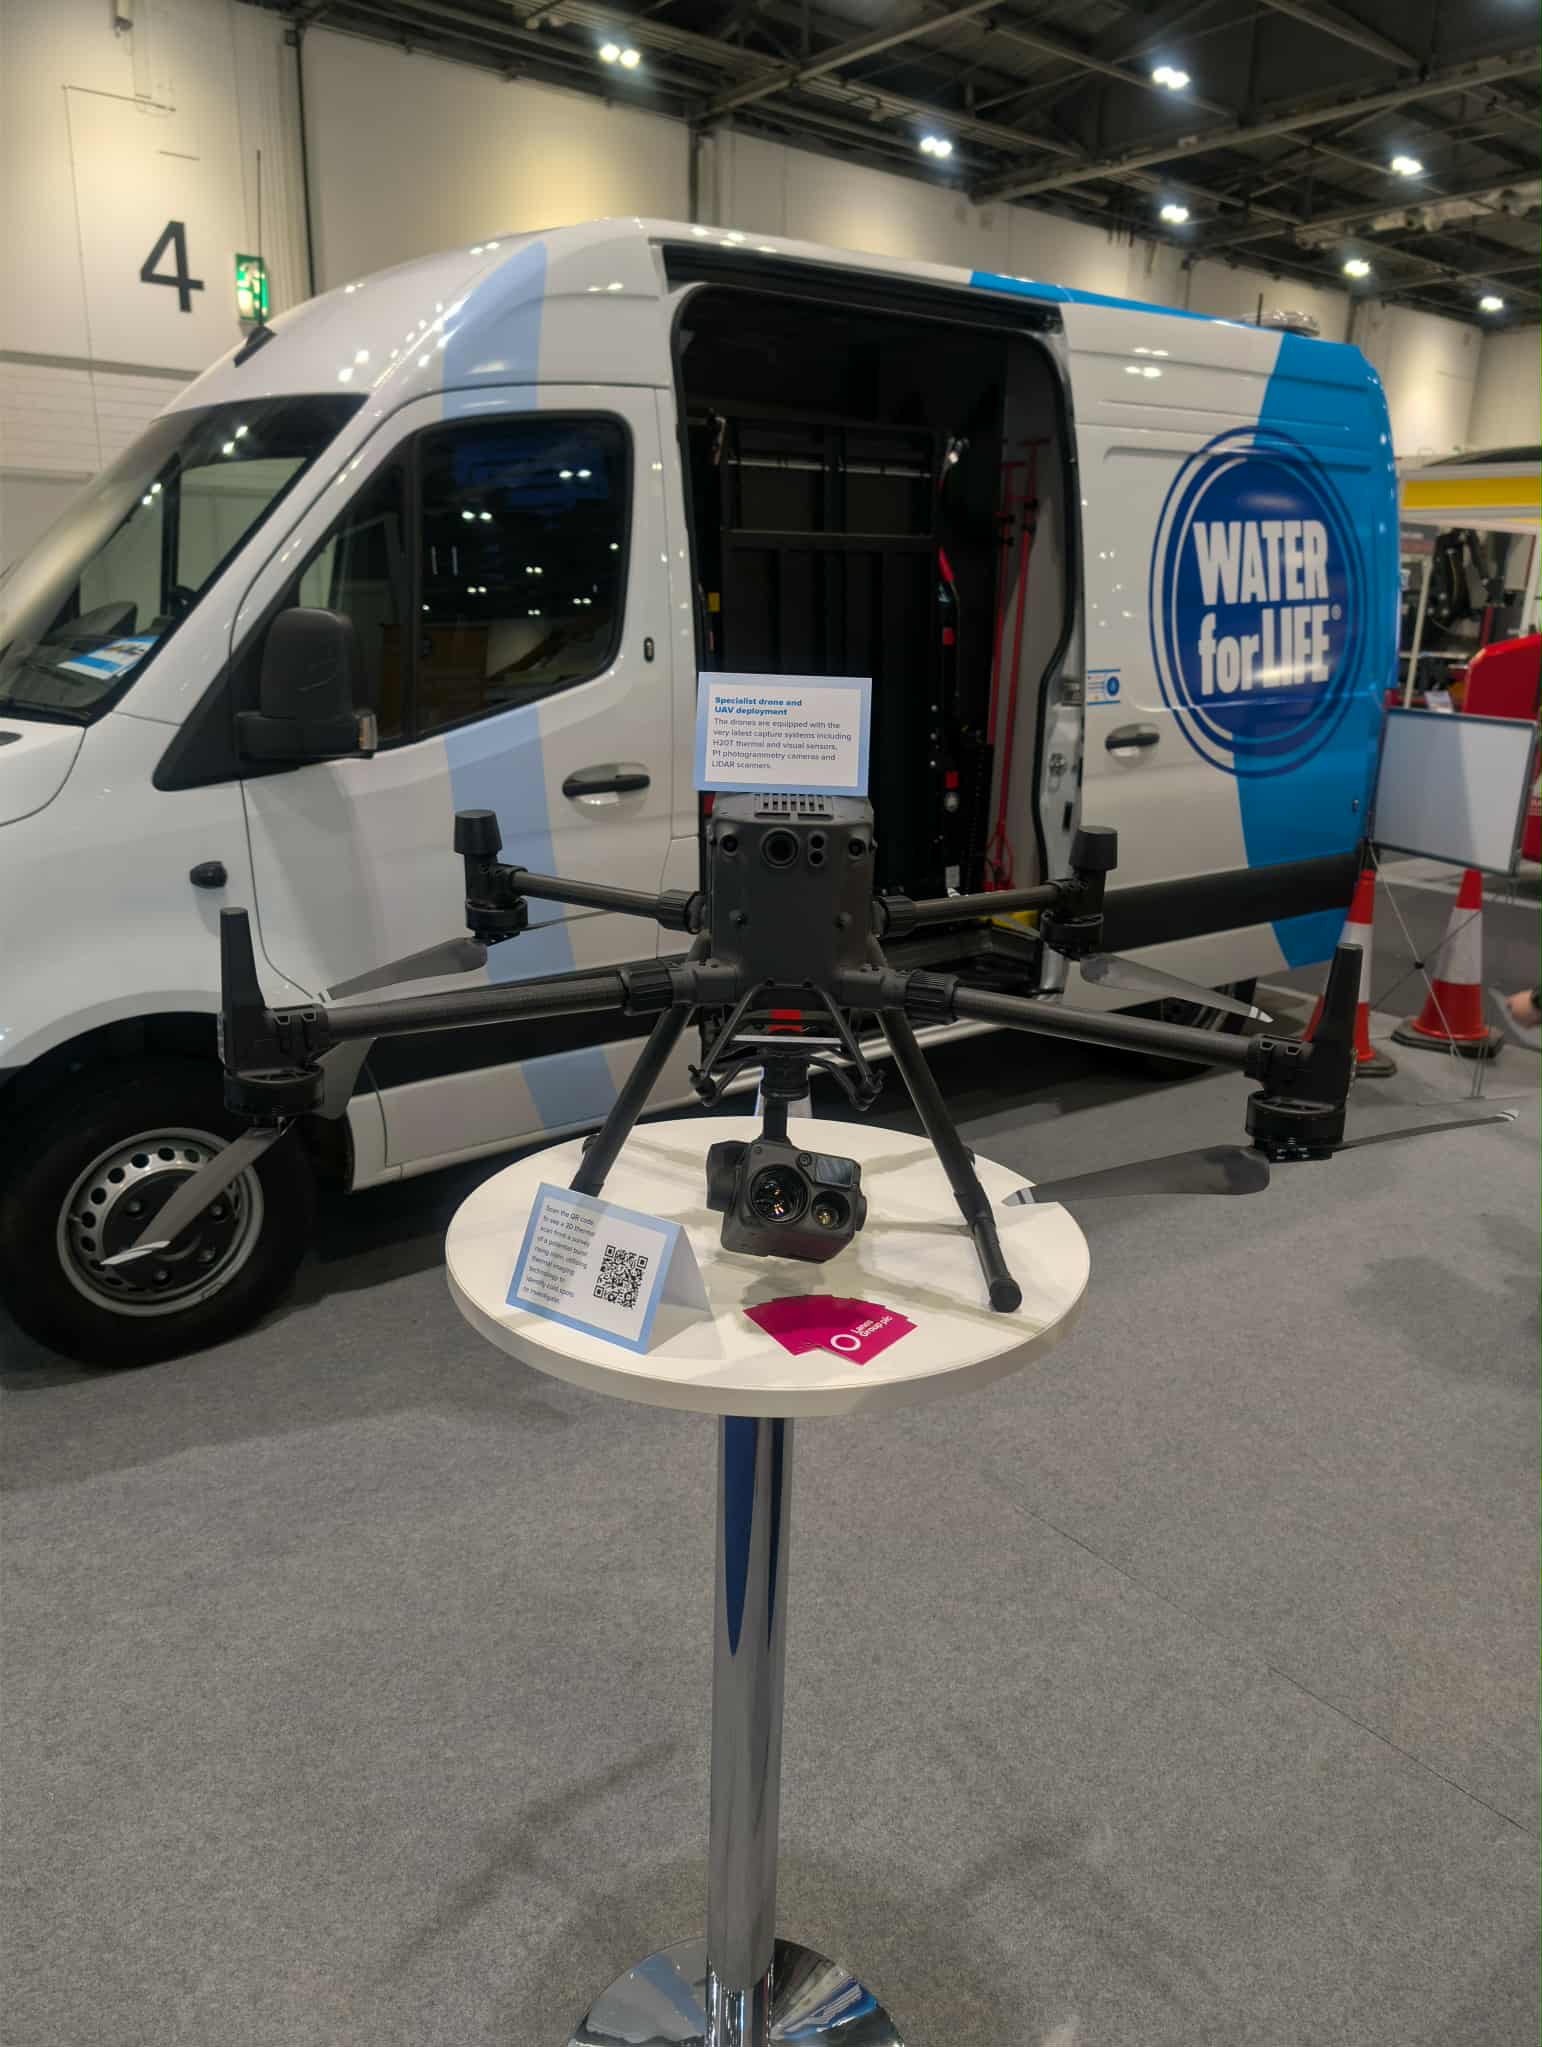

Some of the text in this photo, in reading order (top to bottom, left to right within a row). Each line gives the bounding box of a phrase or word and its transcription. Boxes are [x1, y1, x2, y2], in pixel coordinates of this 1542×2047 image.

[140, 220, 204, 313] 4
[1193, 519, 1328, 606] WATER
[1198, 612, 1259, 696] for
[714, 697, 757, 706] Specialist
[736, 708, 788, 716] deployment
[772, 720, 808, 729] equipped
[731, 729, 752, 737] latest
[754, 730, 783, 739] capture
[766, 741, 781, 749] and
